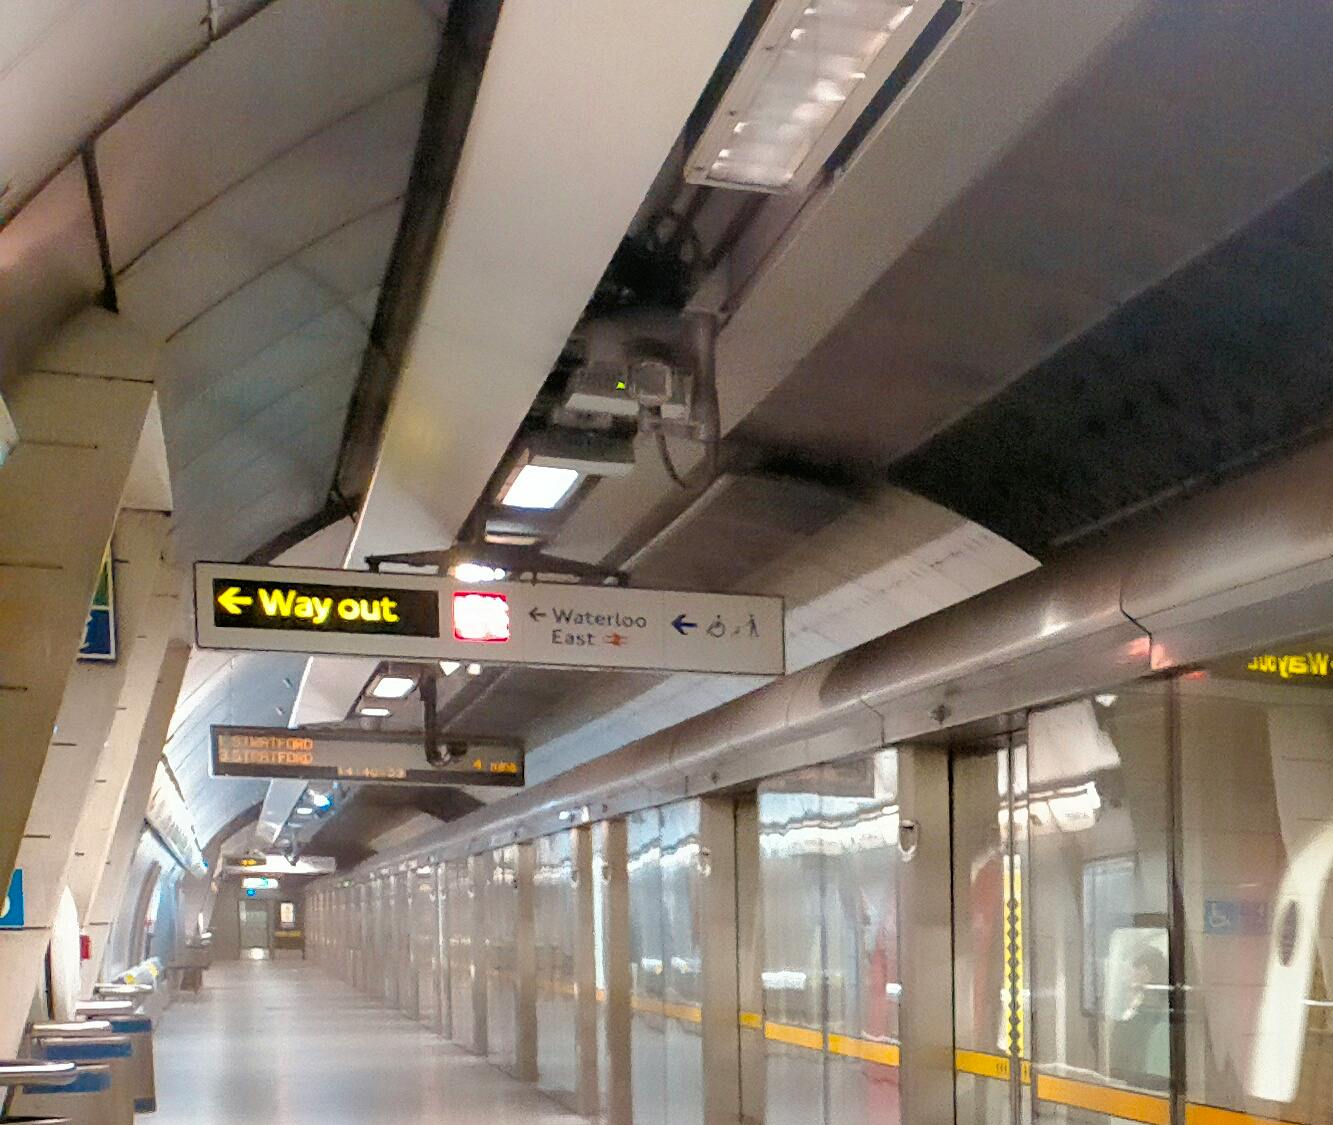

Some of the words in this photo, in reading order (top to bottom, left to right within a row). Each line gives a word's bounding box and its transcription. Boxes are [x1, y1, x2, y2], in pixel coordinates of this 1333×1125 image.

[257, 587, 333, 624] Way
[337, 596, 399, 623] out
[551, 607, 647, 629] Waterloo
[551, 629, 595, 647] East
